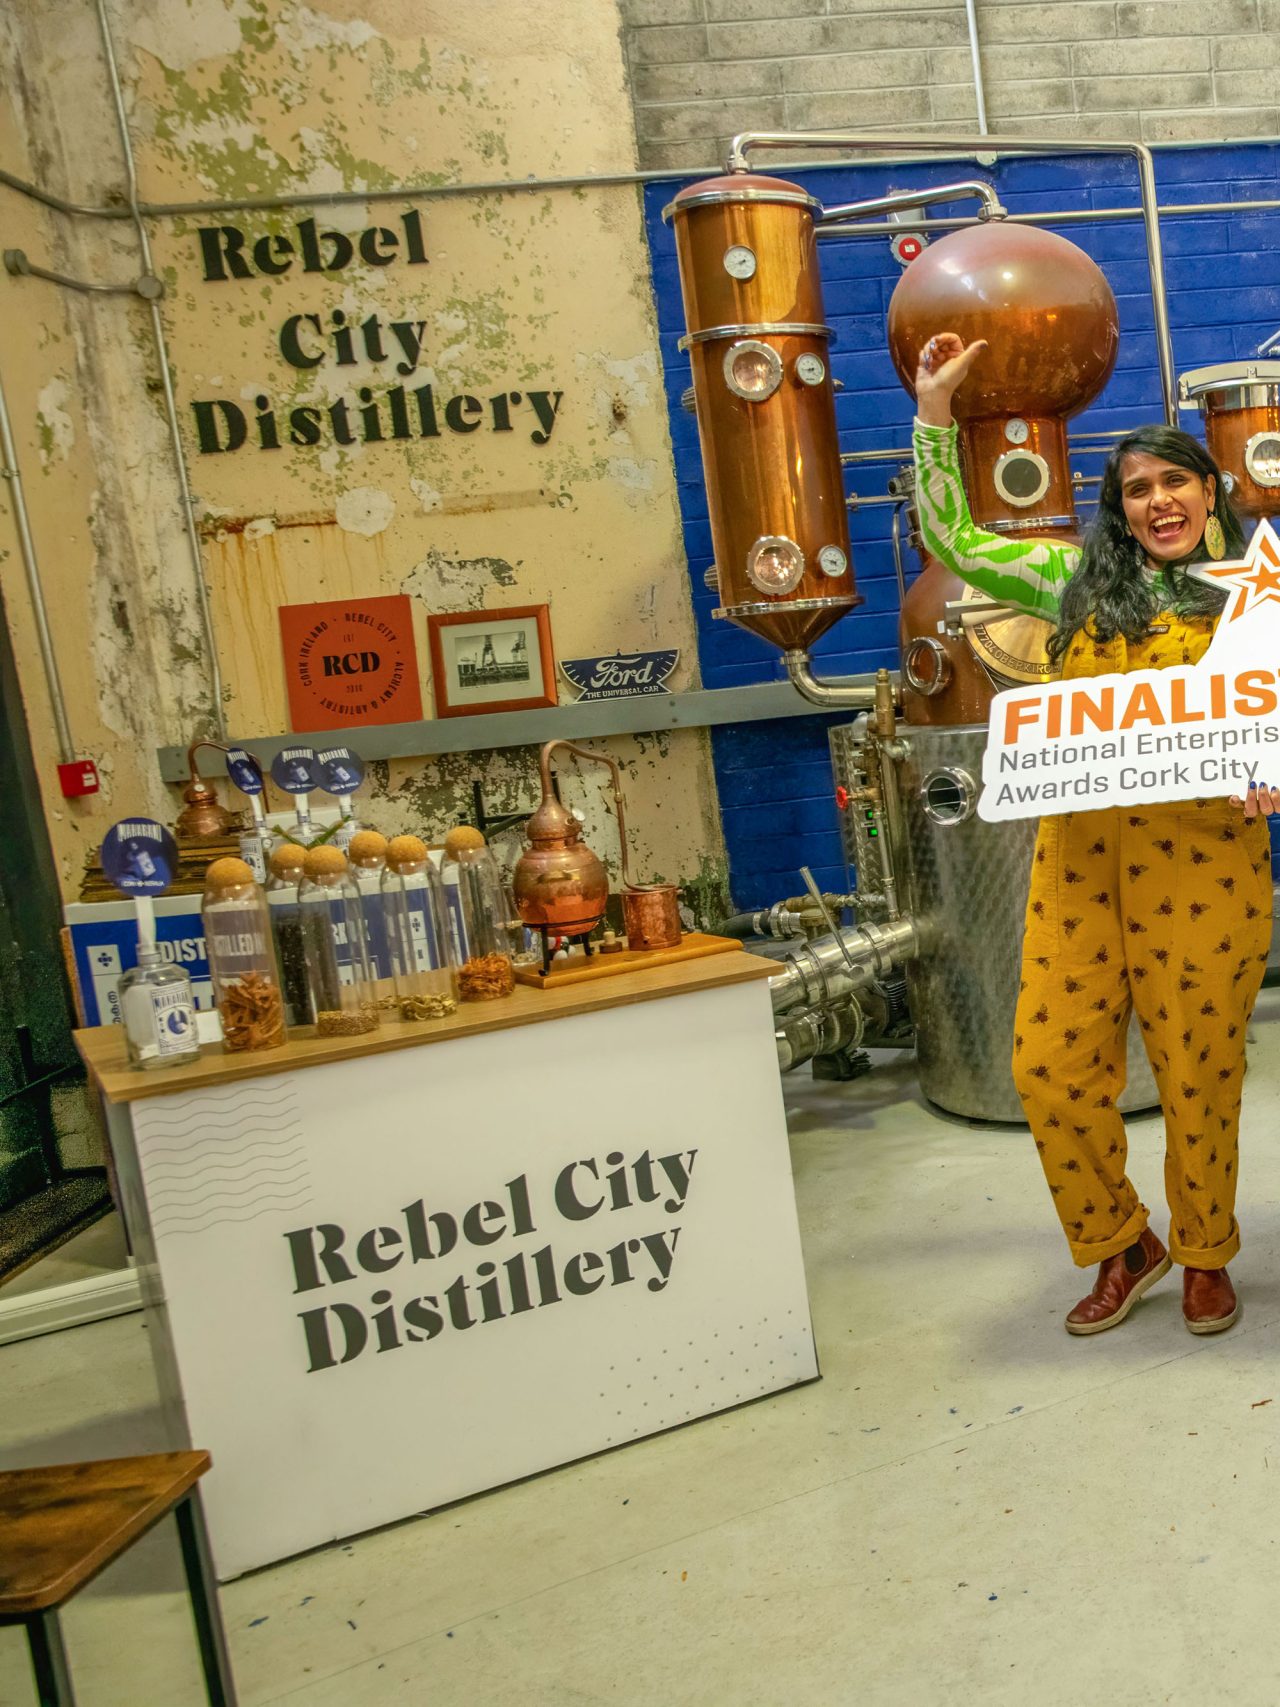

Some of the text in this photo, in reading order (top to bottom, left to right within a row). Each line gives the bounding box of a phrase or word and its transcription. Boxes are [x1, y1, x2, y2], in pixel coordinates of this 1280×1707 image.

[197, 209, 428, 282] Rebel
[279, 309, 427, 375] City
[191, 384, 564, 454] Distillery
[376, 622, 397, 642] CITY
[322, 651, 380, 677] RCD
[590, 656, 654, 688] Ford
[603, 688, 642, 698] UNIVERSAL
[643, 685, 659, 693] CAR
[1000, 736, 1125, 773] National
[996, 757, 1259, 806] Awards Cork City
[283, 1149, 699, 1294] Rebel City
[297, 1227, 682, 1373] Distillery
